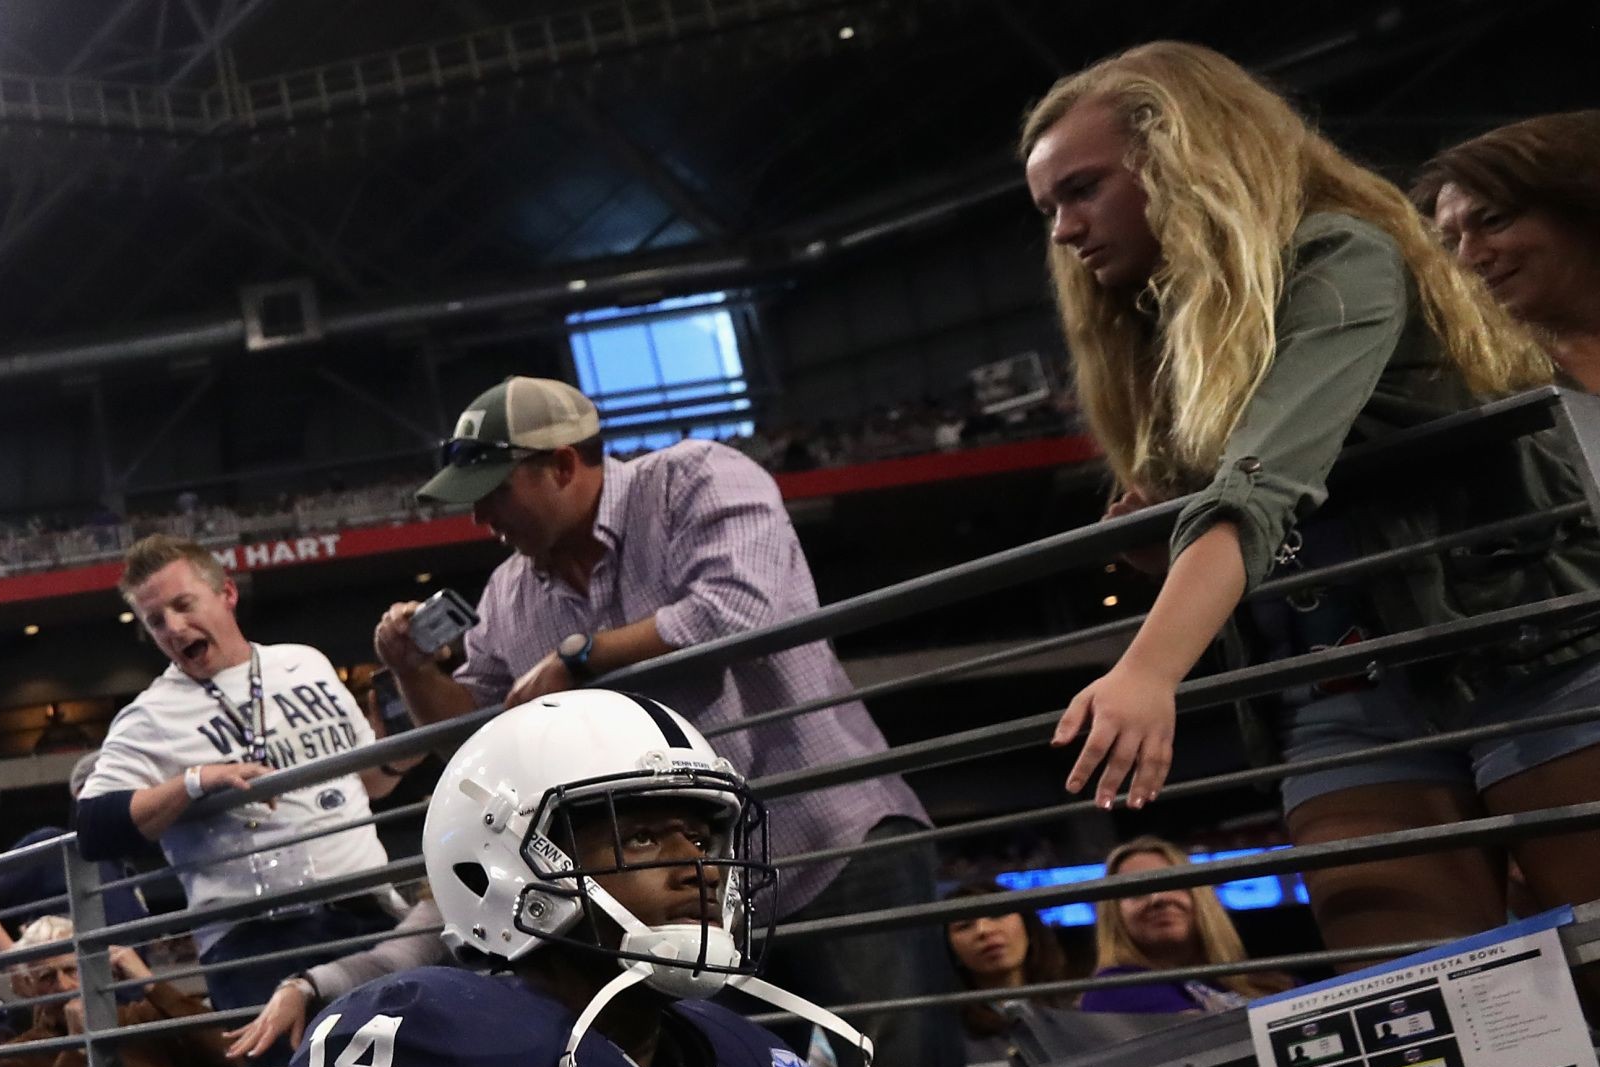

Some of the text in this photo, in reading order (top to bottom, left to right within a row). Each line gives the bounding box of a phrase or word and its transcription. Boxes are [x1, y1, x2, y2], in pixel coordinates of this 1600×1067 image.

[245, 534, 340, 567] HART
[272, 682, 348, 729] ARE
[1420, 958, 1462, 975] FIESTA
[1468, 946, 1507, 962] BOWL
